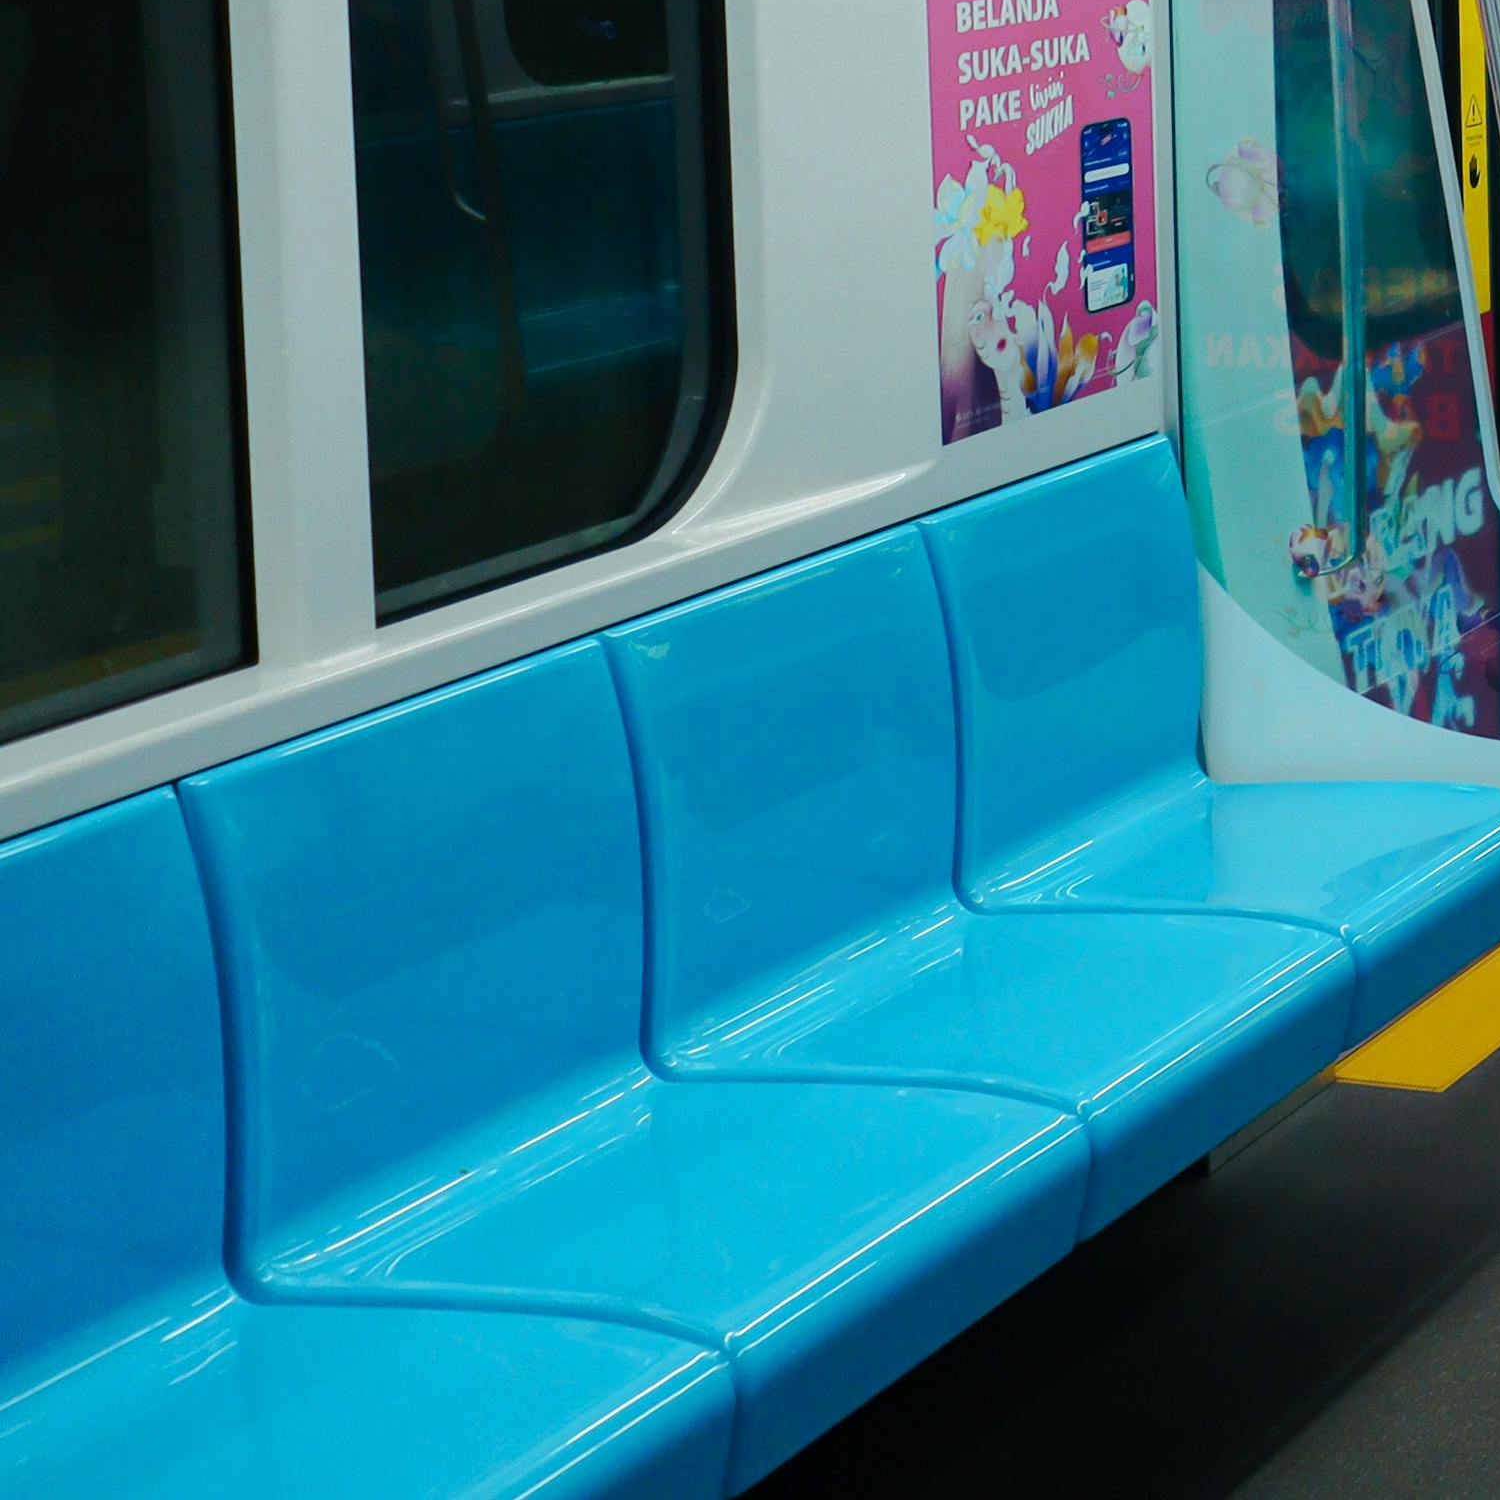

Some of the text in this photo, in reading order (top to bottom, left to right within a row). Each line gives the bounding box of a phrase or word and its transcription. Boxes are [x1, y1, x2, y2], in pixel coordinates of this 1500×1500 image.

[957, 32, 1091, 85] SUKA-SUKA
[959, 89, 1022, 131] PAKE
[1025, 95, 1075, 156] SUKHA
